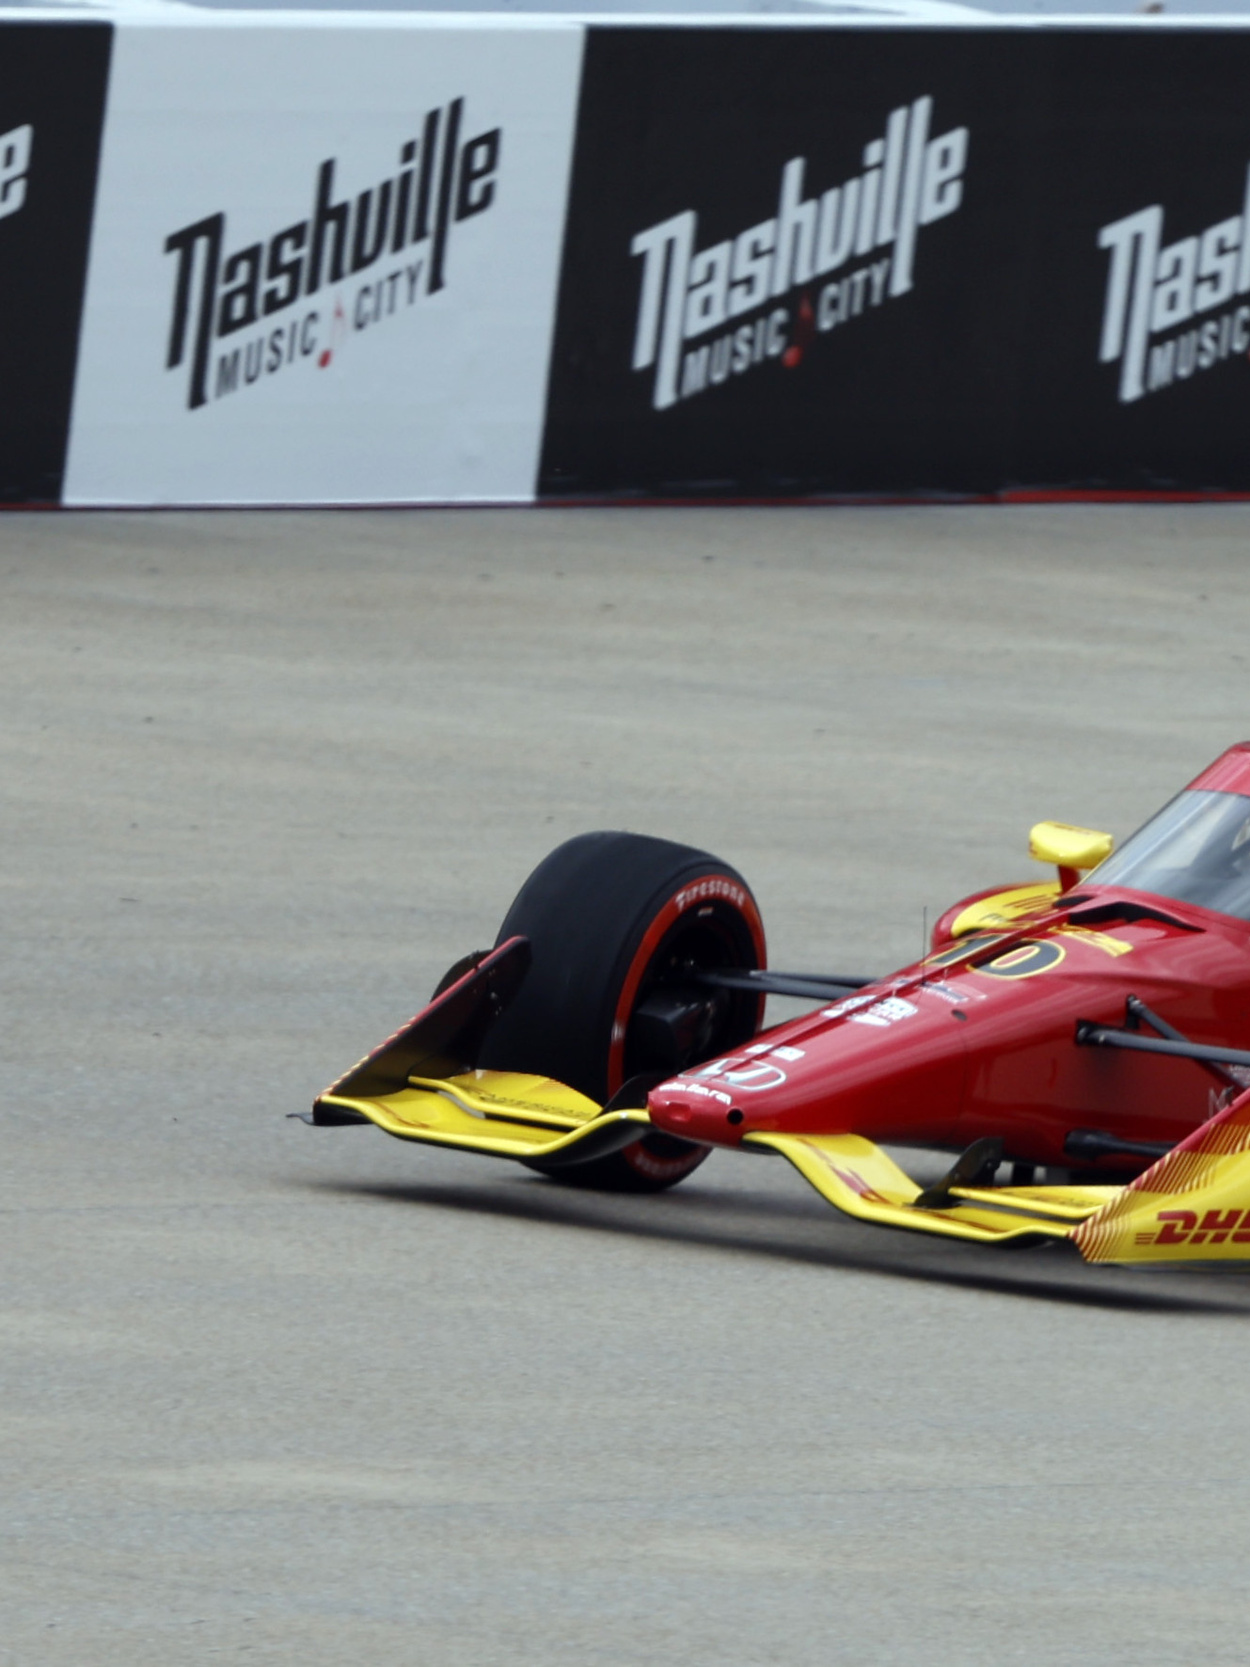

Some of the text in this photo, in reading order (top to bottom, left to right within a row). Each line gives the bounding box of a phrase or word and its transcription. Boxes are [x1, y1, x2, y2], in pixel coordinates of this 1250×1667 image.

[215, 259, 426, 397] MUSIC CITY
[682, 259, 890, 397] MUSIC CITY
